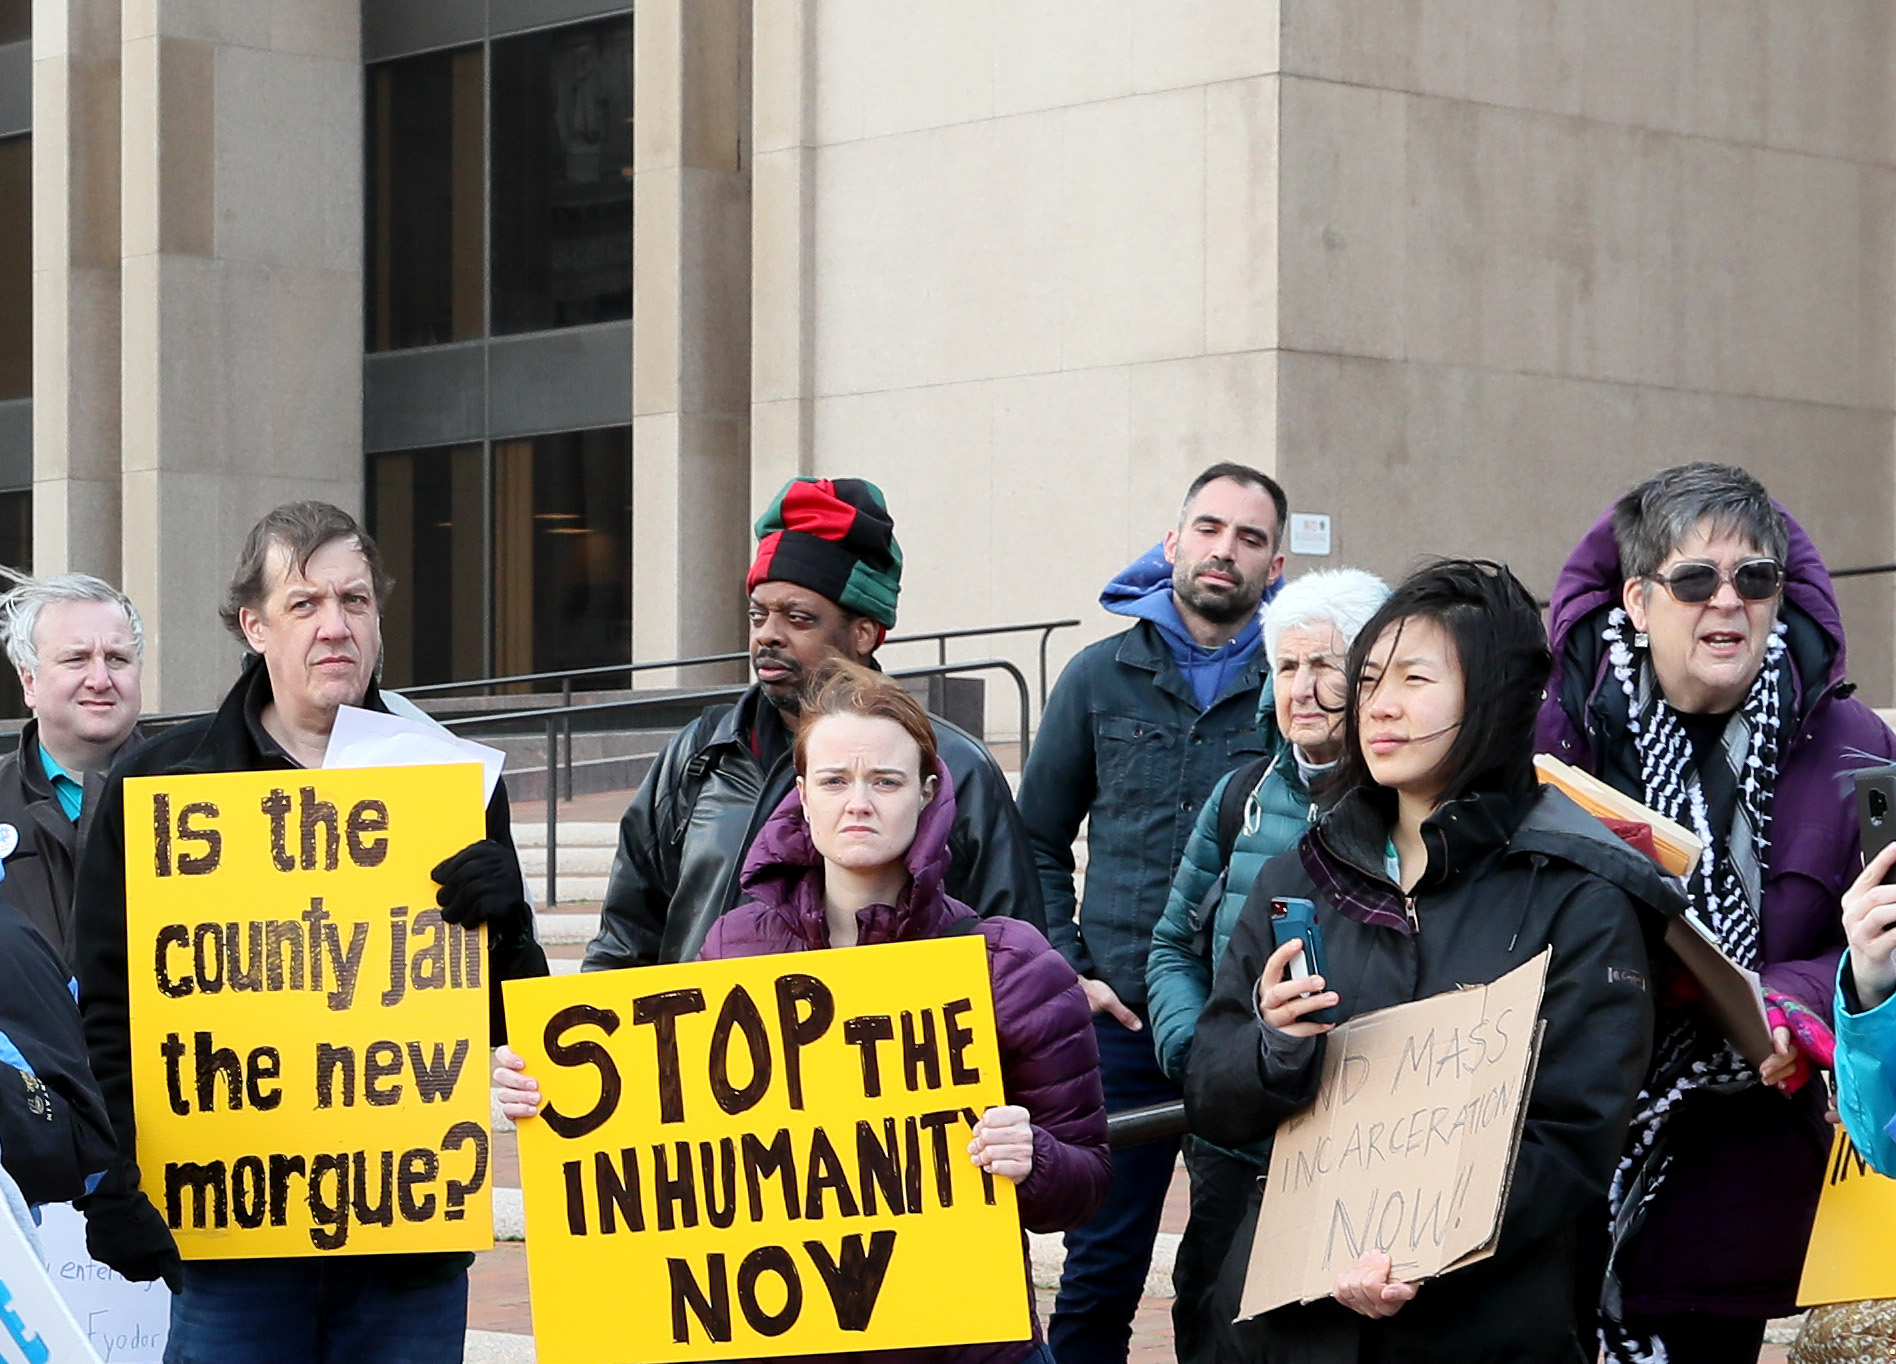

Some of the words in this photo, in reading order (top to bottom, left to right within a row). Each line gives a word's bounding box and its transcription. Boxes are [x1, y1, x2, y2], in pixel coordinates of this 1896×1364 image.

[152, 792, 222, 877] Is
[260, 786, 390, 873] the
[155, 897, 369, 1011] county
[160, 1031, 283, 1117] the
[313, 1038, 470, 1110] new
[539, 973, 836, 1140] STOP
[843, 998, 981, 1098] THE
[1391, 1008, 1513, 1096] MASS
[164, 1121, 490, 1250] morgue?
[666, 1230, 897, 1345] NOW
